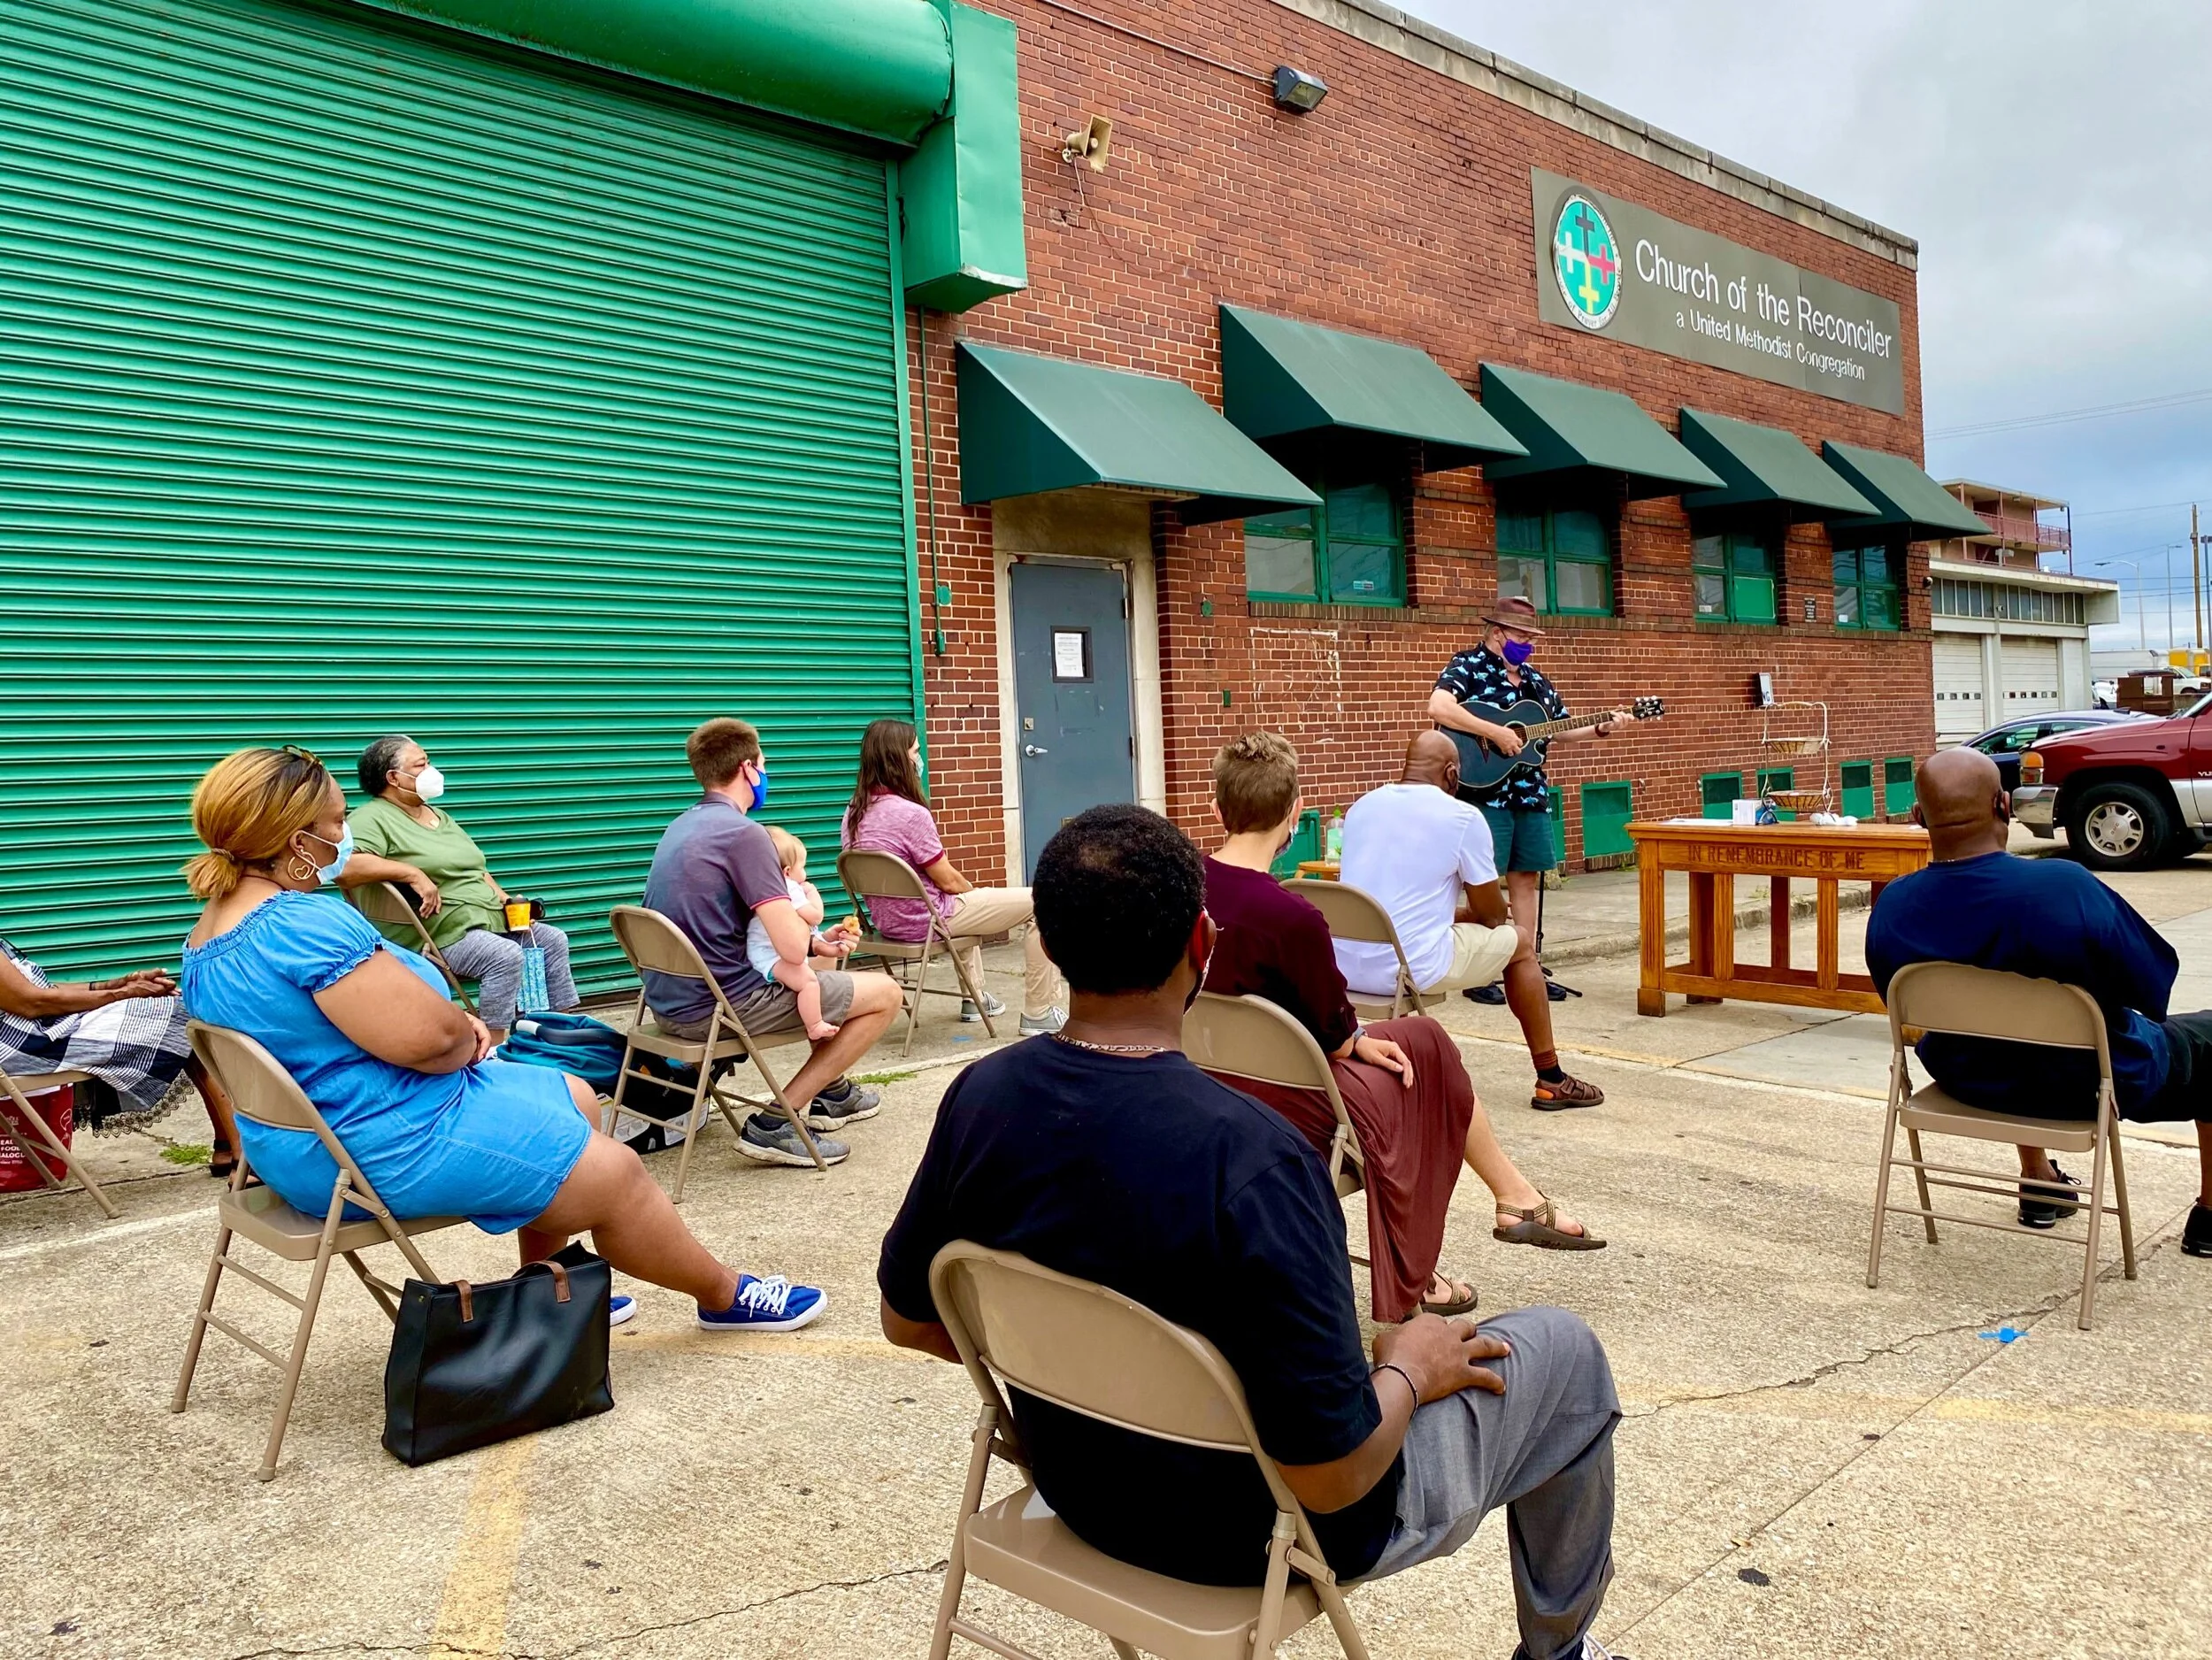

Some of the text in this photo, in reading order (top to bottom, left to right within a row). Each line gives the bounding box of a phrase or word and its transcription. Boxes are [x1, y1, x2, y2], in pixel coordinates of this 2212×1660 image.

[1635, 238, 1892, 358] Church of the Reconciler
[1676, 308, 1865, 380] a United Methodist Congregation
[1688, 844, 1865, 870] IN REMEMBRANCE OF ME
